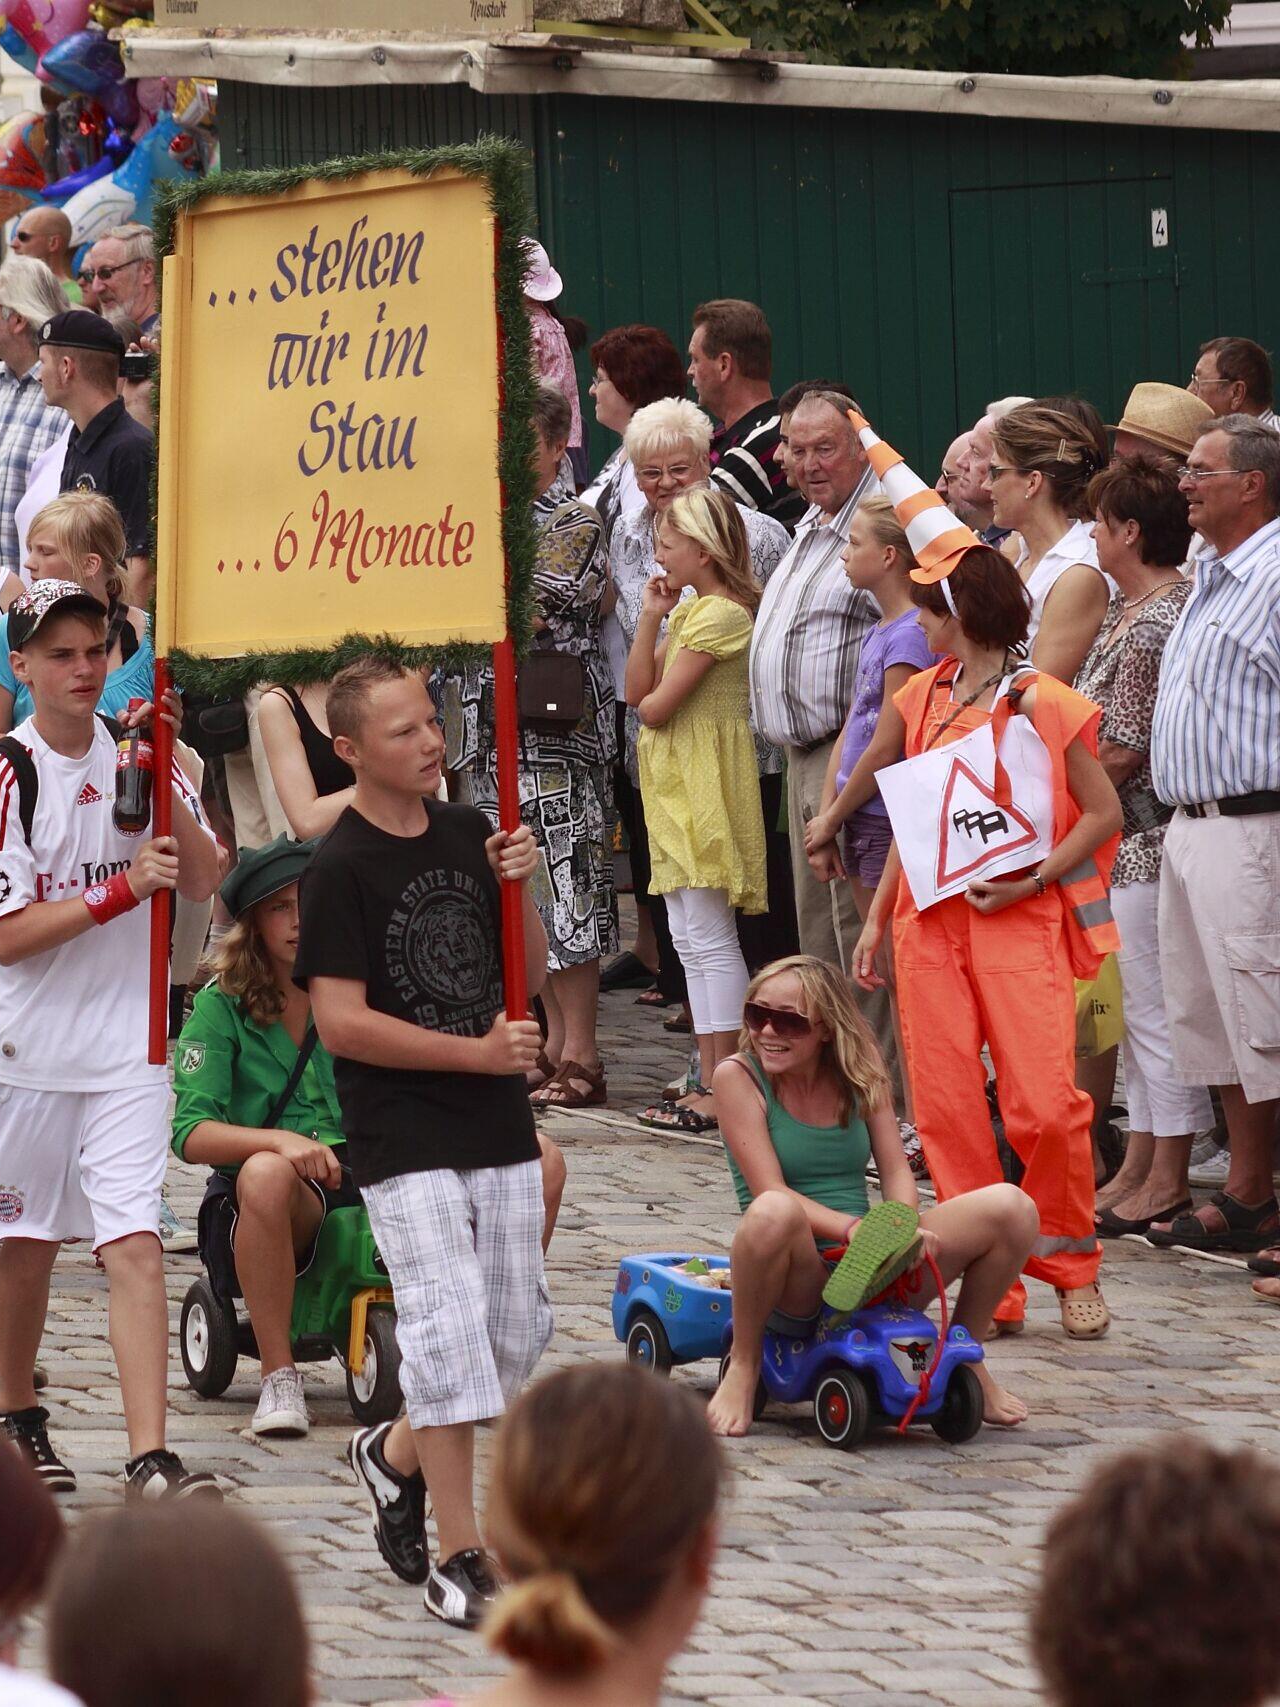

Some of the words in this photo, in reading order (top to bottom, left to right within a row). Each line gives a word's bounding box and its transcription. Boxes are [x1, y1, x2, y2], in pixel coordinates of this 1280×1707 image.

[1156, 219, 1165, 236] 4
[268, 309, 350, 391] wir
[364, 302, 429, 381] im
[298, 400, 417, 477] Stau
[309, 490, 476, 583] Monate
[77, 793, 103, 806] adidas
[401, 869, 447, 908] STATE
[385, 908, 419, 1002] EASTERN
[912, 1362, 926, 1372] BIG
